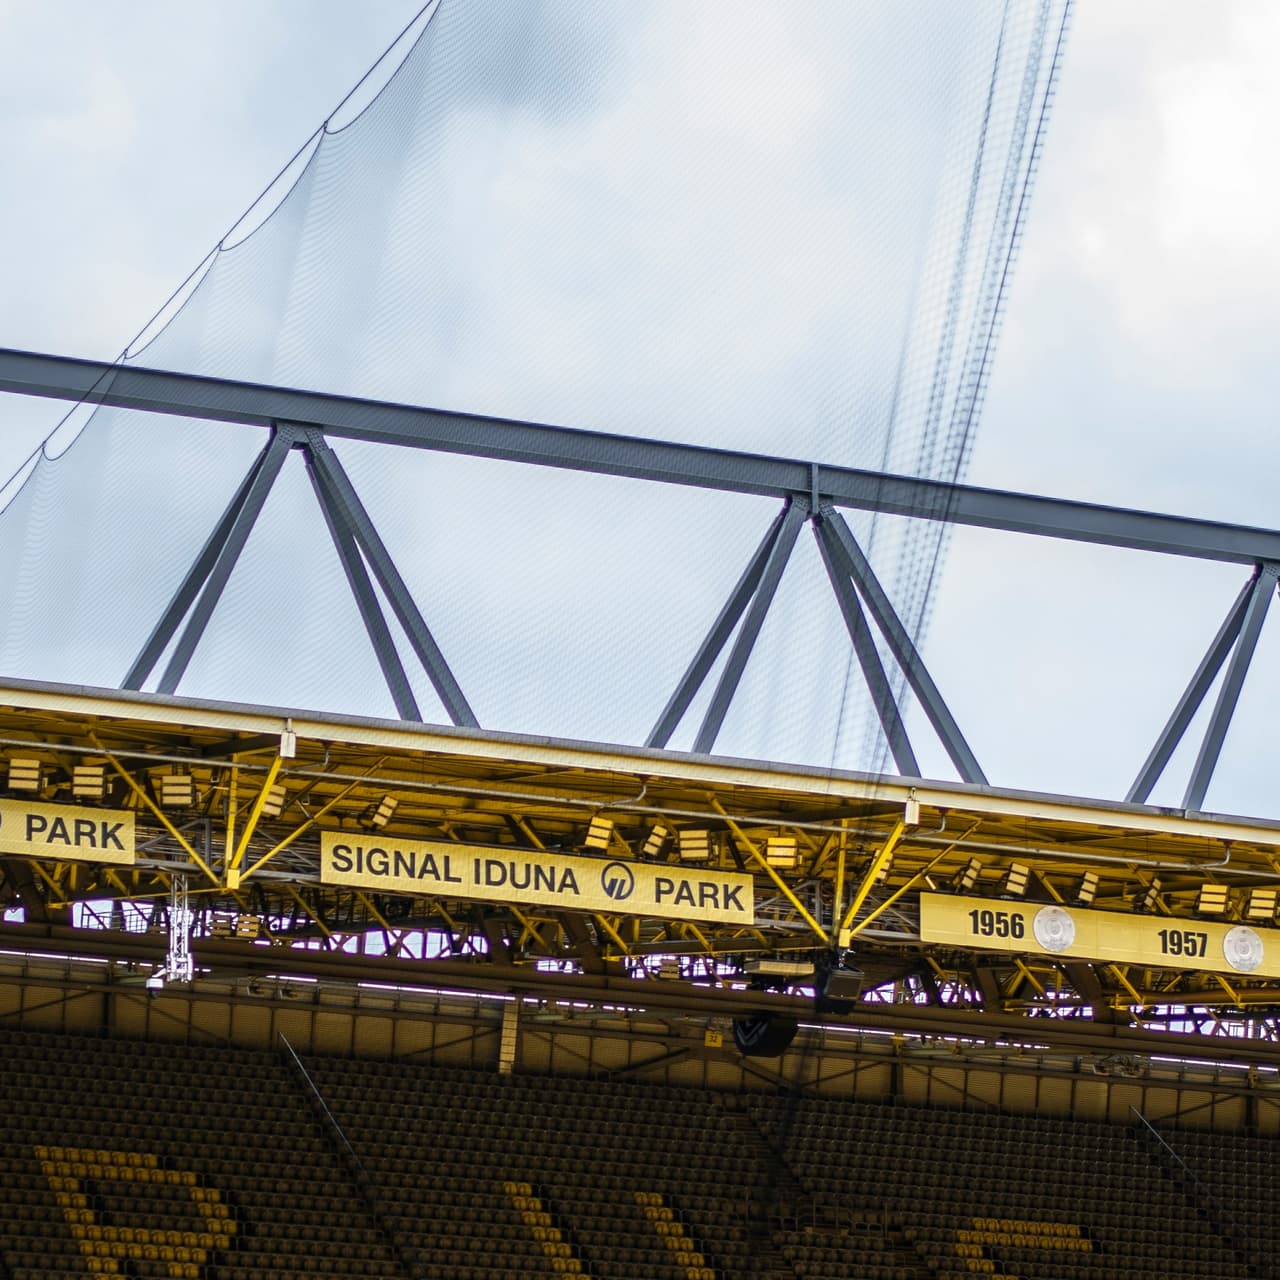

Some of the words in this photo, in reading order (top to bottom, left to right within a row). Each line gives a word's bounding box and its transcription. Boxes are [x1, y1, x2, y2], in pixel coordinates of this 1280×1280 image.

[25, 814, 126, 851] PARK
[331, 844, 462, 884] SIGNAL
[474, 858, 580, 895] IDUNA
[655, 877, 745, 912] PARK
[968, 909, 1025, 939] 1956
[1157, 929, 1208, 958] 1957
